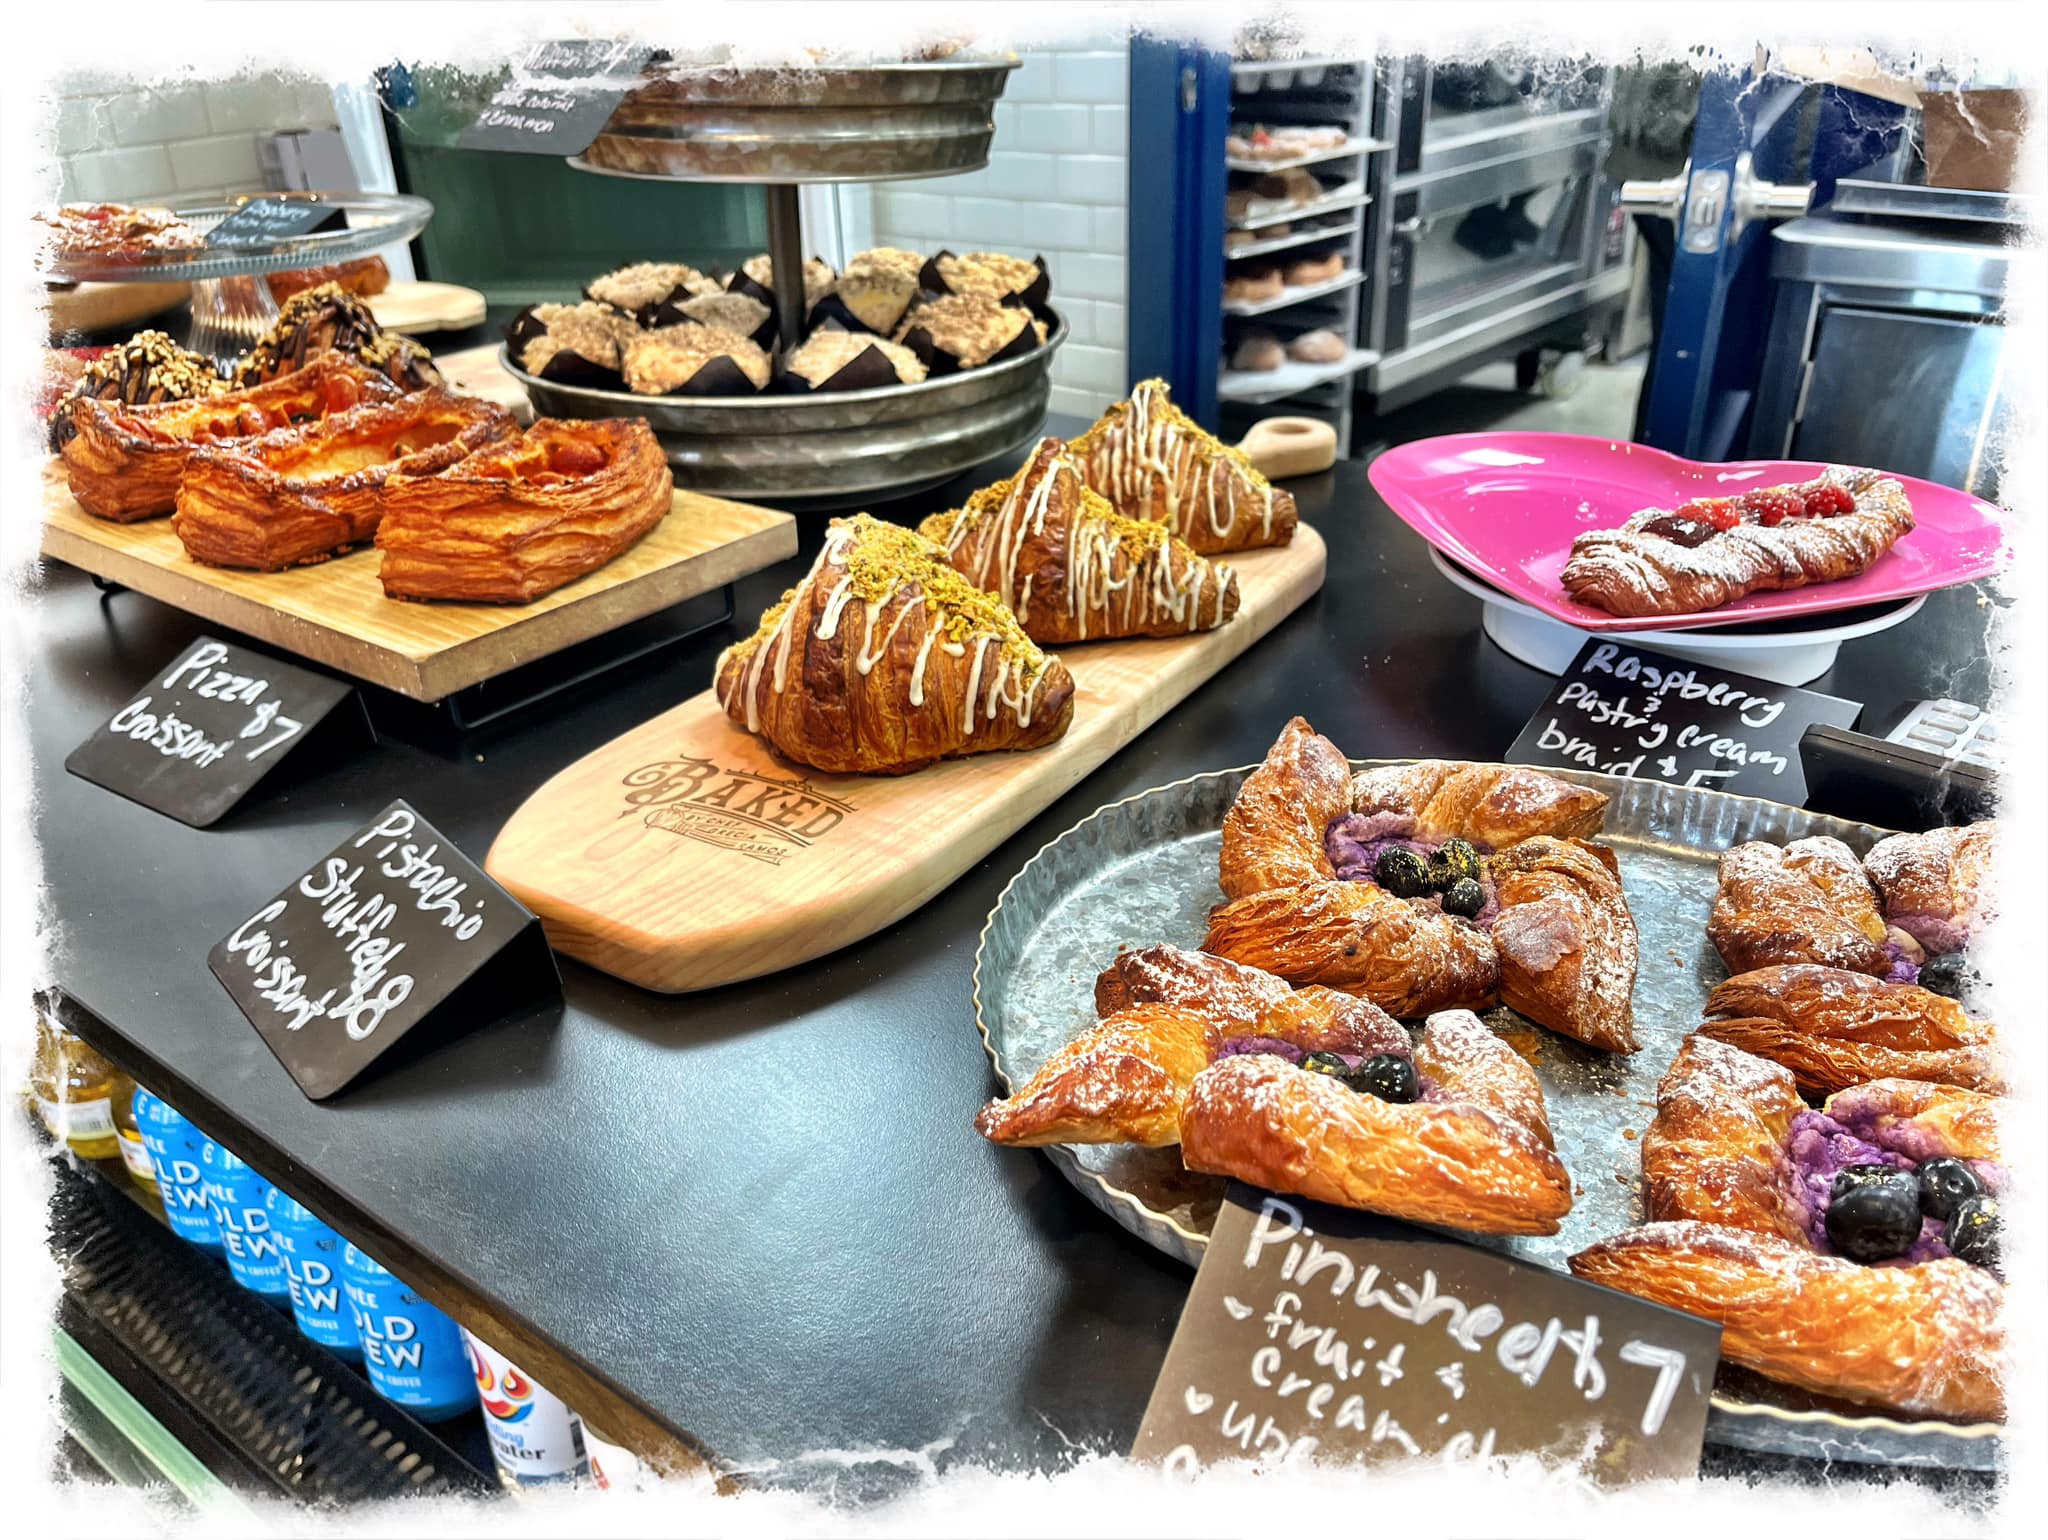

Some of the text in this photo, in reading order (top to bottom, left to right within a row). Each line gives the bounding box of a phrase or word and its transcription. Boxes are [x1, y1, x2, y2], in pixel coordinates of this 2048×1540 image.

[163, 643, 269, 705] Pizza
[1582, 644, 1785, 727] Raspberry
[618, 754, 845, 839] BAKED
[355, 810, 486, 941] Pistachio
[152, 1156, 200, 1186] LD
[279, 1255, 332, 1286] LD
[1264, 1291, 1405, 1386] fruit
[1251, 1346, 1421, 1456] cream
